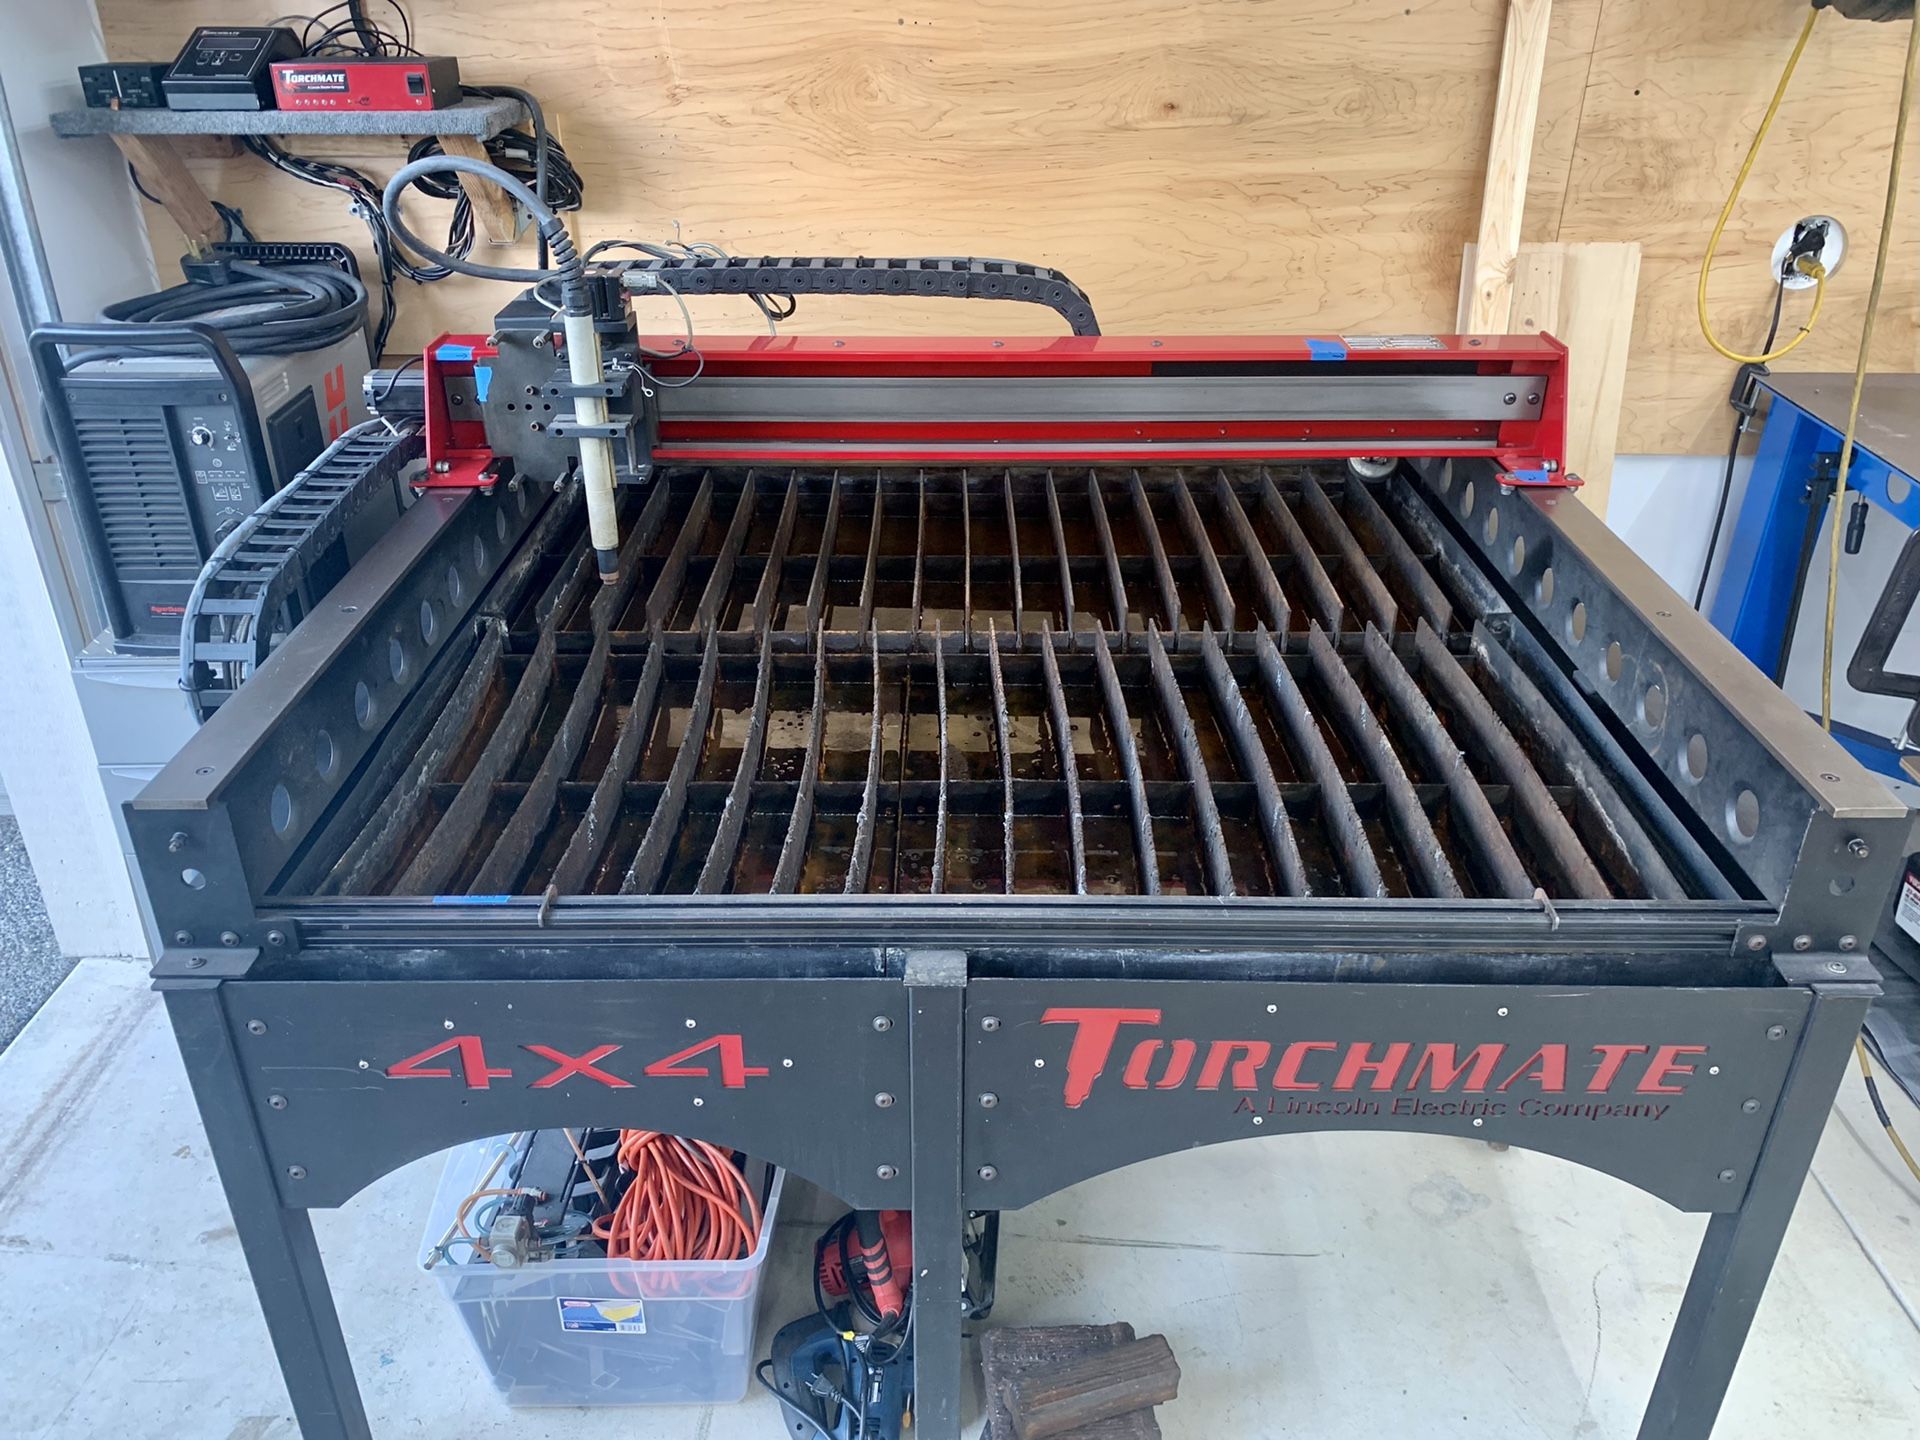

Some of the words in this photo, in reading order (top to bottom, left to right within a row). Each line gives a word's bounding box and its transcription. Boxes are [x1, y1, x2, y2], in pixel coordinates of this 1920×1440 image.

[282, 69, 345, 84] TORCHMATE
[1040, 1007, 1709, 1109] TORCHMATE
[1233, 1097, 1256, 1115] A
[1267, 1097, 1380, 1116] Lincoln
[1391, 1097, 1508, 1117] Electric
[1518, 1098, 1670, 1121] Company
